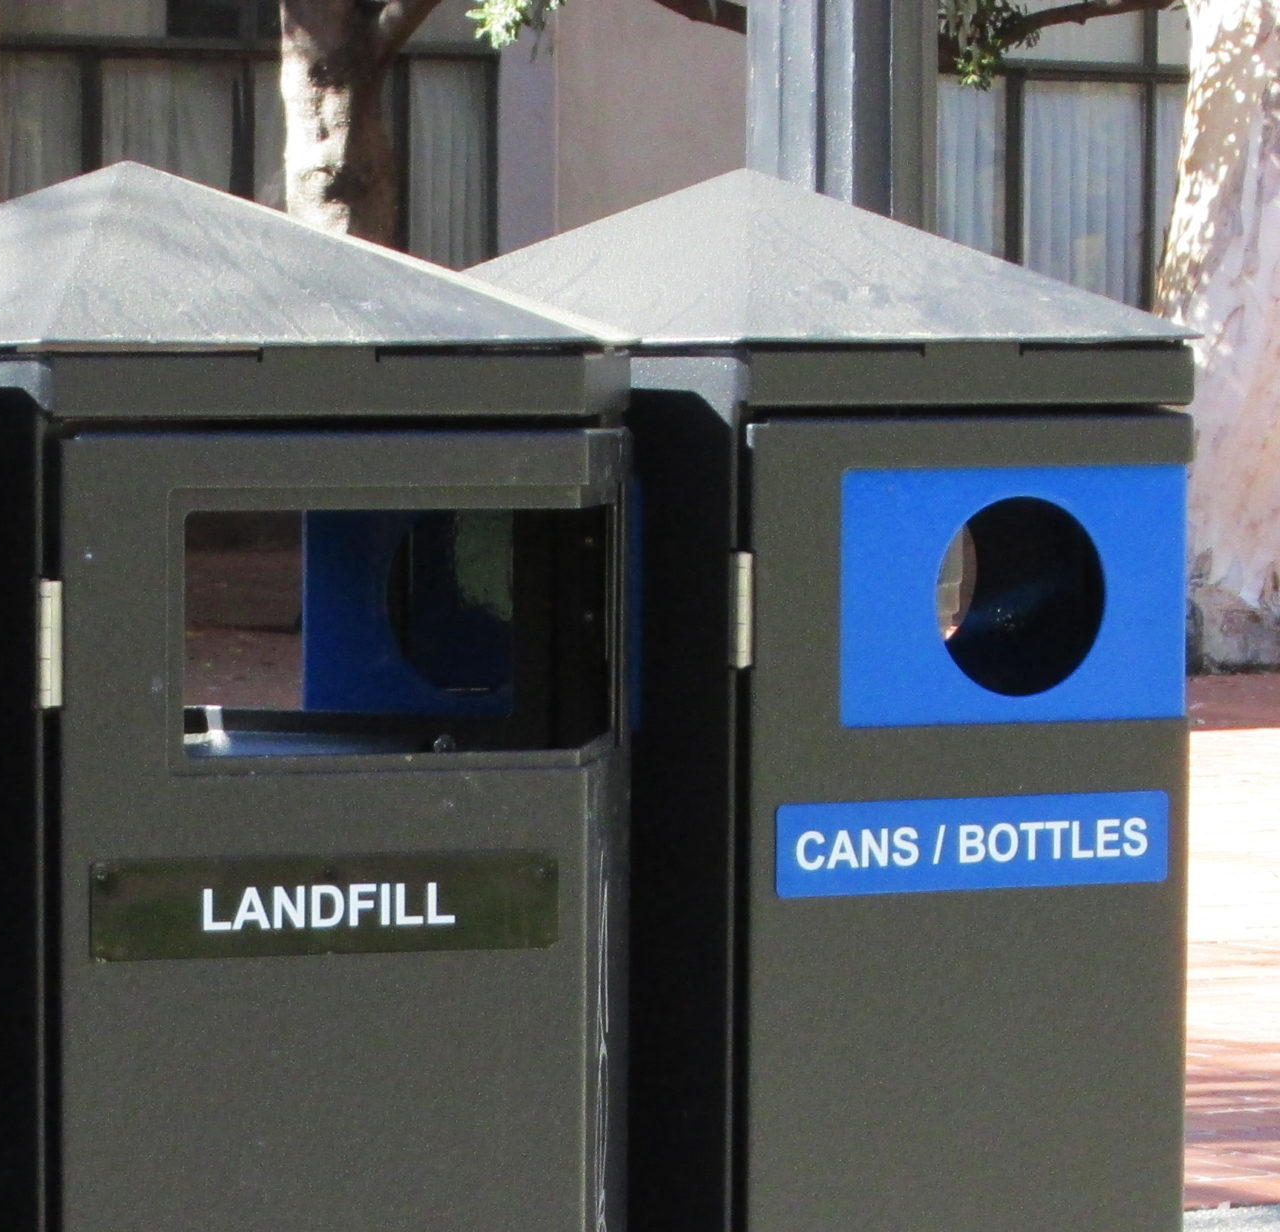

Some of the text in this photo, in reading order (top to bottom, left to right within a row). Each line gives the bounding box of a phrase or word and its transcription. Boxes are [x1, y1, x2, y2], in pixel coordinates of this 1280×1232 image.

[796, 827, 920, 870] CANS
[959, 817, 1149, 863] BOTTLES
[202, 882, 456, 932] LANDFILL
